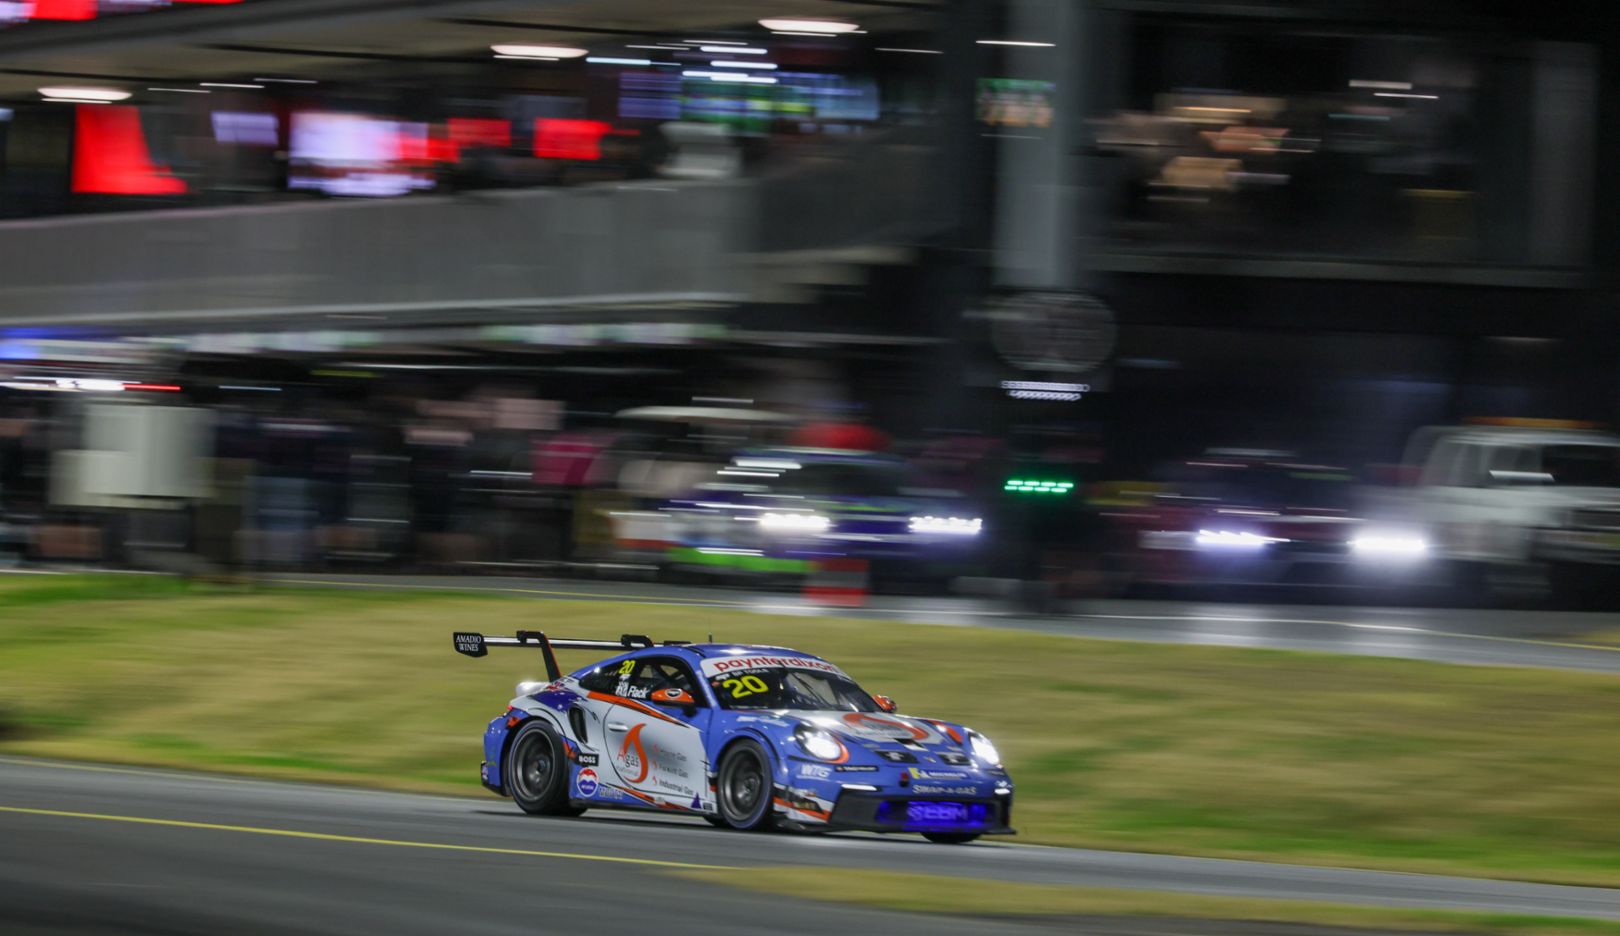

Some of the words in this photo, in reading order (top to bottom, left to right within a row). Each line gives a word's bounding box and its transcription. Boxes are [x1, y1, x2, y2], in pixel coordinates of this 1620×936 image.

[459, 643, 479, 652] WINES
[618, 660, 637, 674] 20
[721, 675, 769, 700] 20
[578, 755, 597, 764] BOSS
